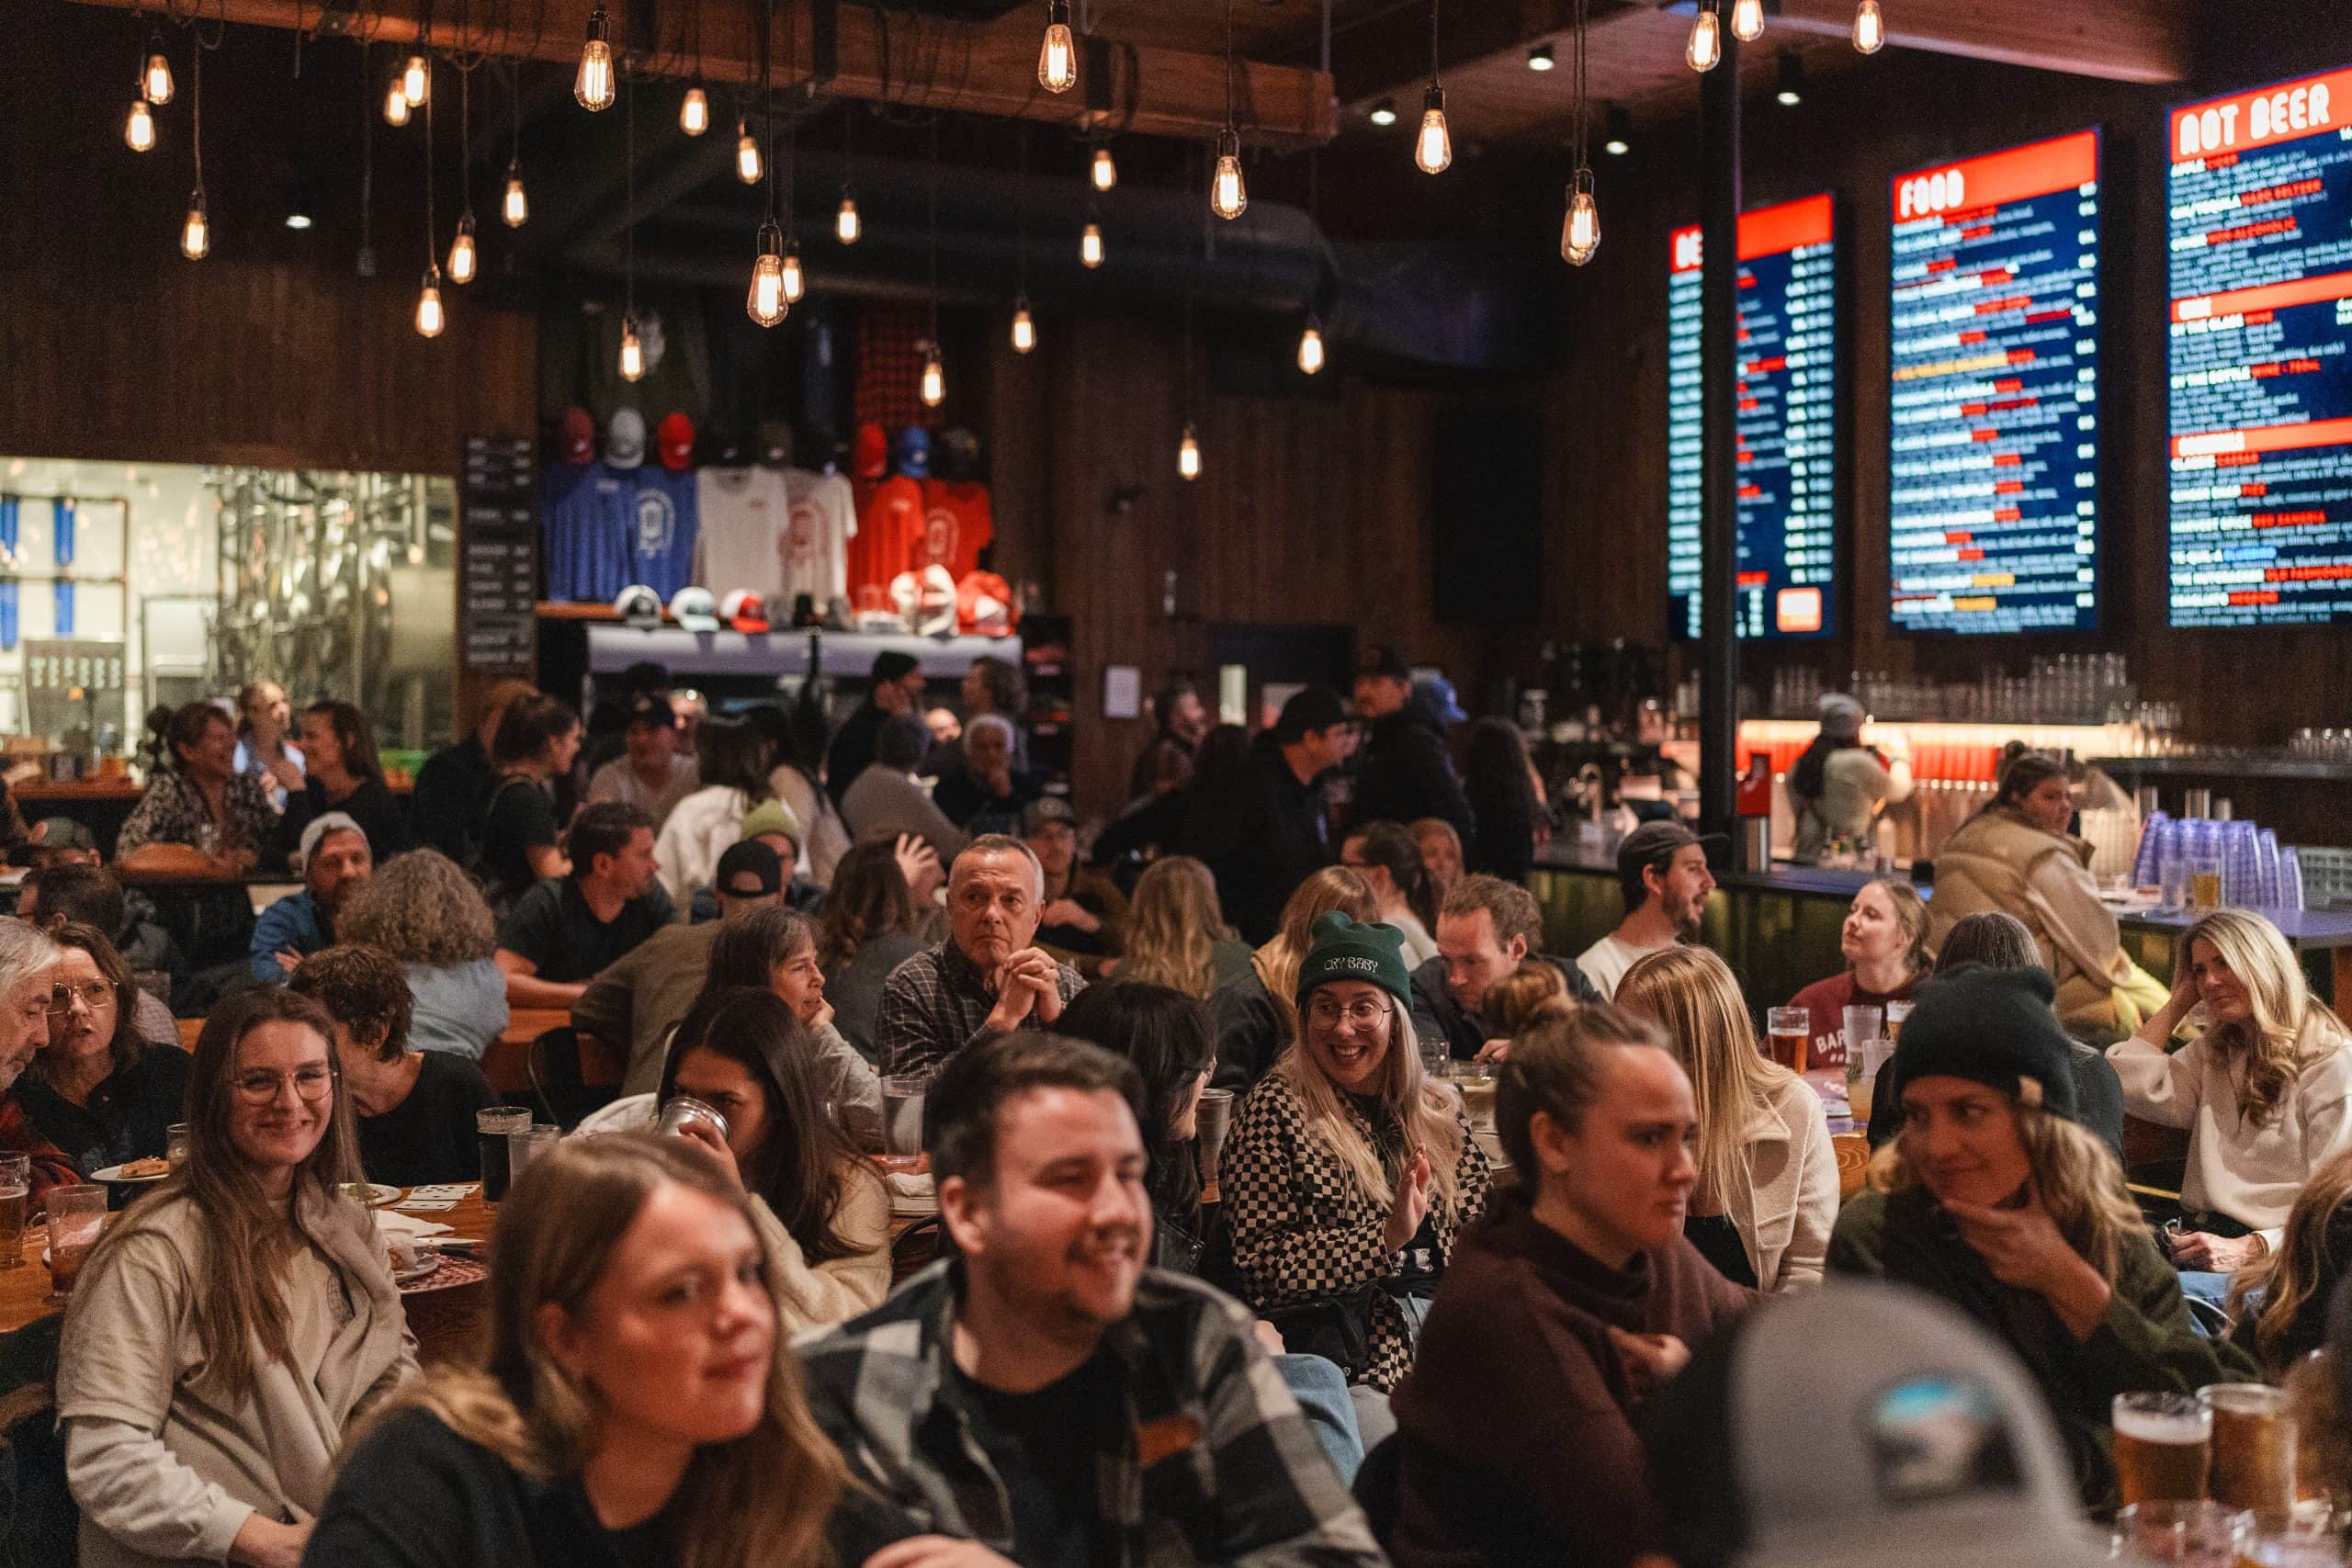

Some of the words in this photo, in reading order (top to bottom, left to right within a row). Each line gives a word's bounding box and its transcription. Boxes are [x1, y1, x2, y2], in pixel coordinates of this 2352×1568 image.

[2179, 104, 2240, 156] NOT
[2250, 83, 2330, 140] BEER
[1900, 169, 1964, 218] FOOD
[1676, 231, 1702, 268] BE
[1324, 957, 1345, 971] CRY
[1348, 956, 1378, 974] BABY
[1815, 1029, 1847, 1055] BAR
